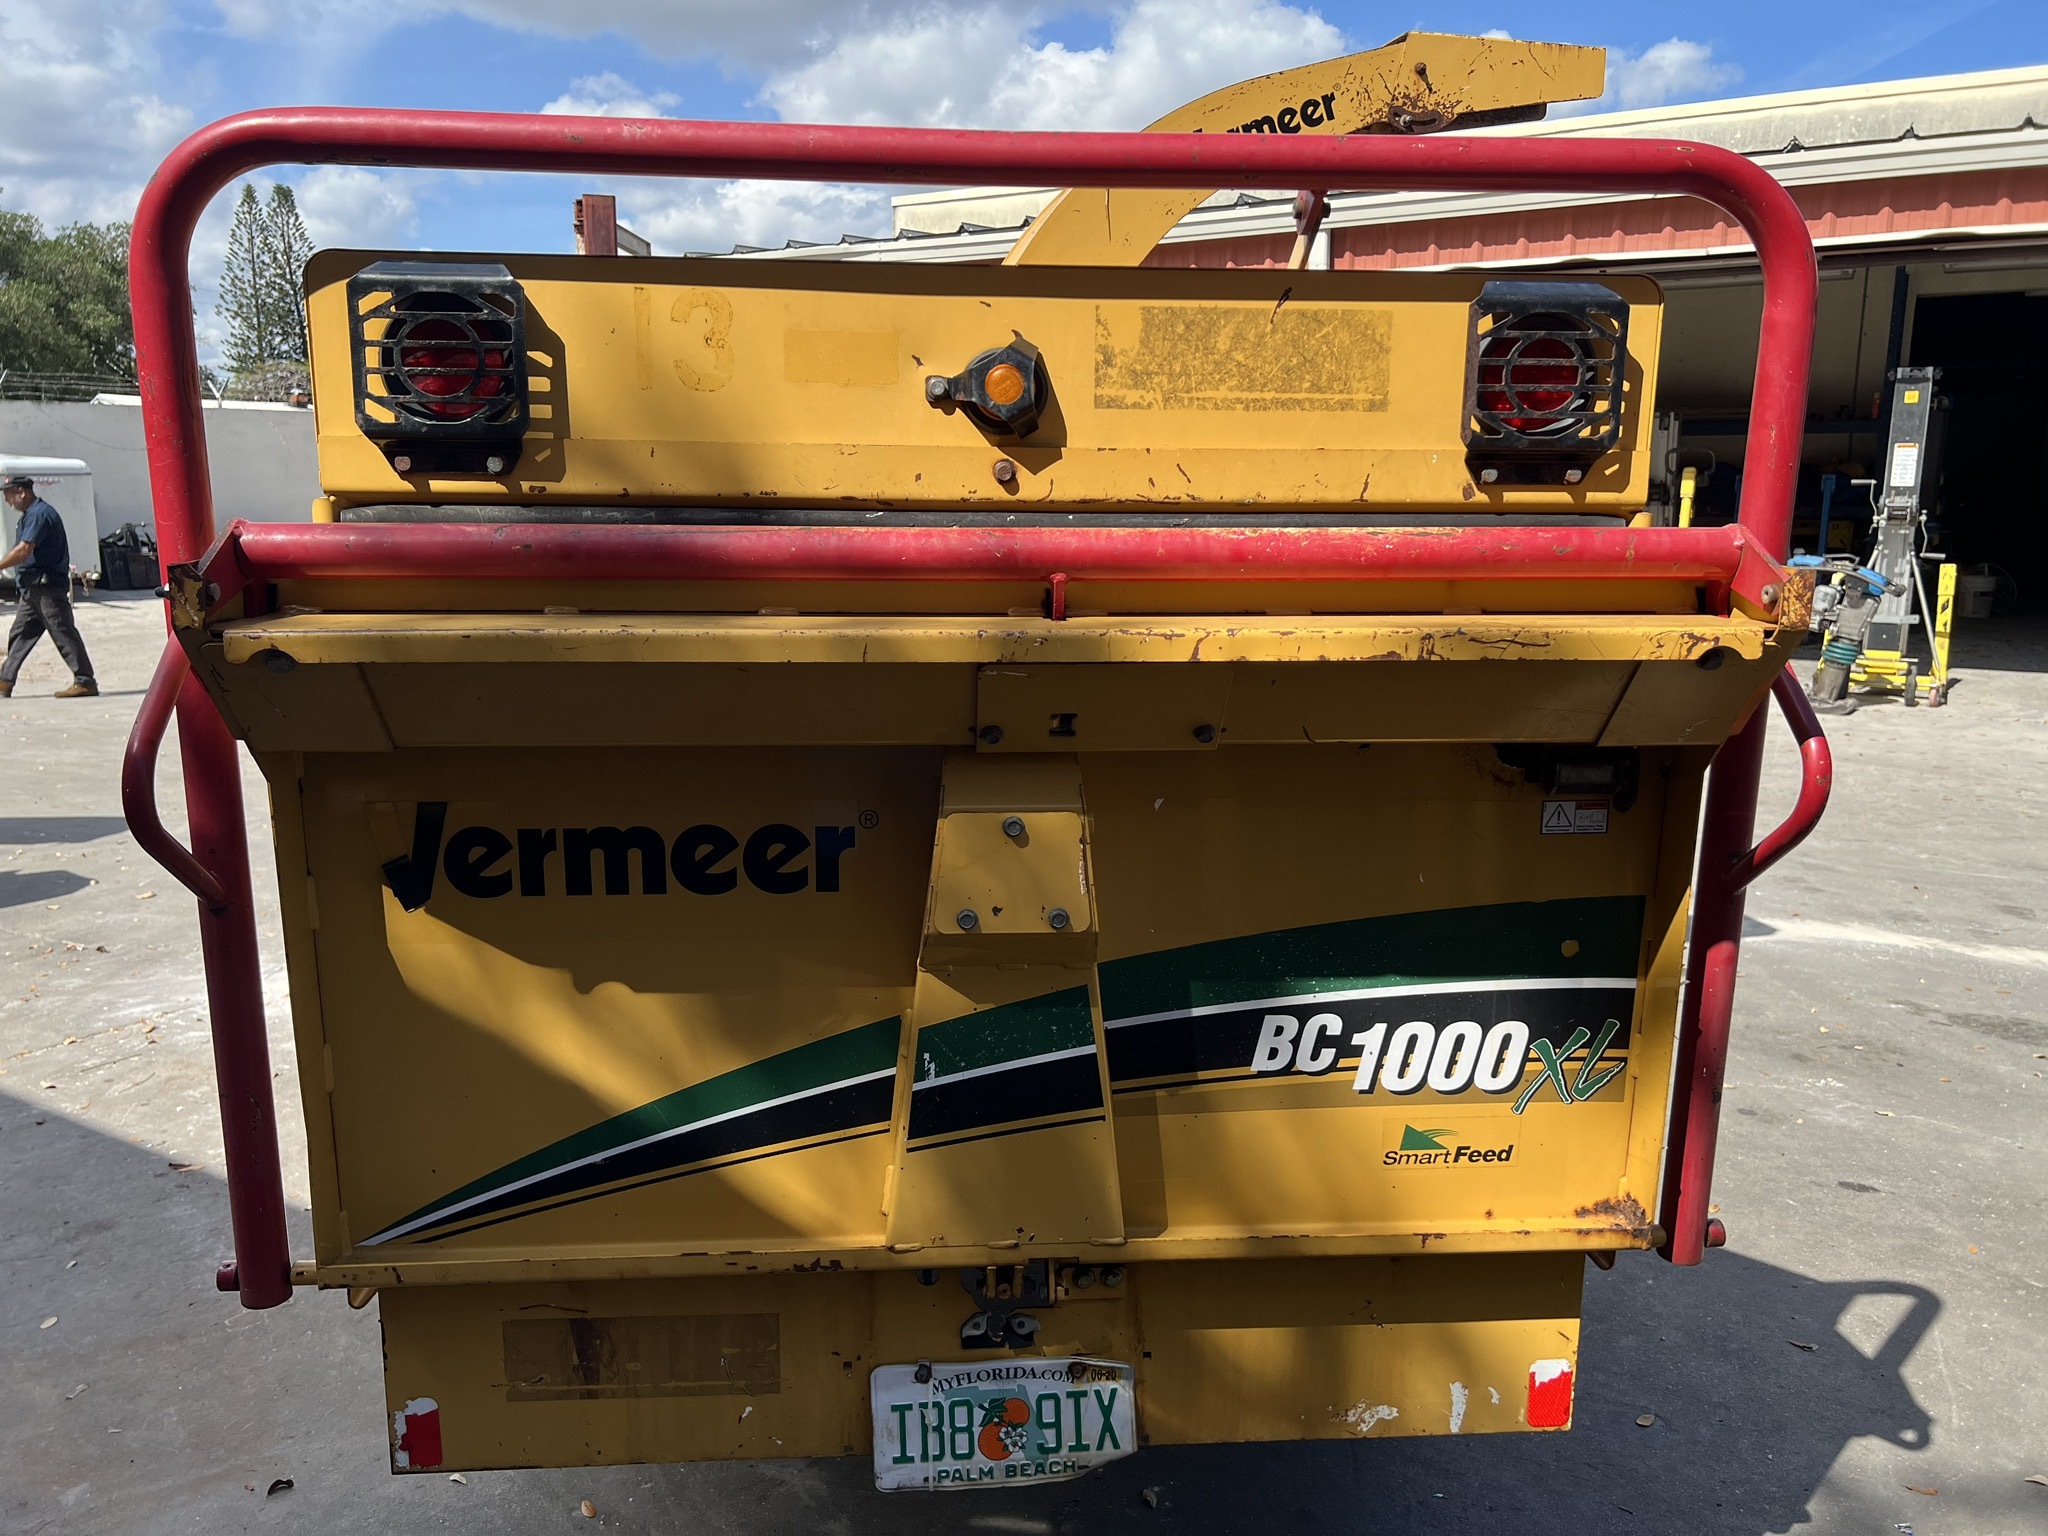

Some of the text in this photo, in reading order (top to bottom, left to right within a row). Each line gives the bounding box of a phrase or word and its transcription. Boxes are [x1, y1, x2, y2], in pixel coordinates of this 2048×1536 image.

[1035, 1386, 1122, 1456] 9IX
[936, 1457, 1077, 1484] PALM BEACH
